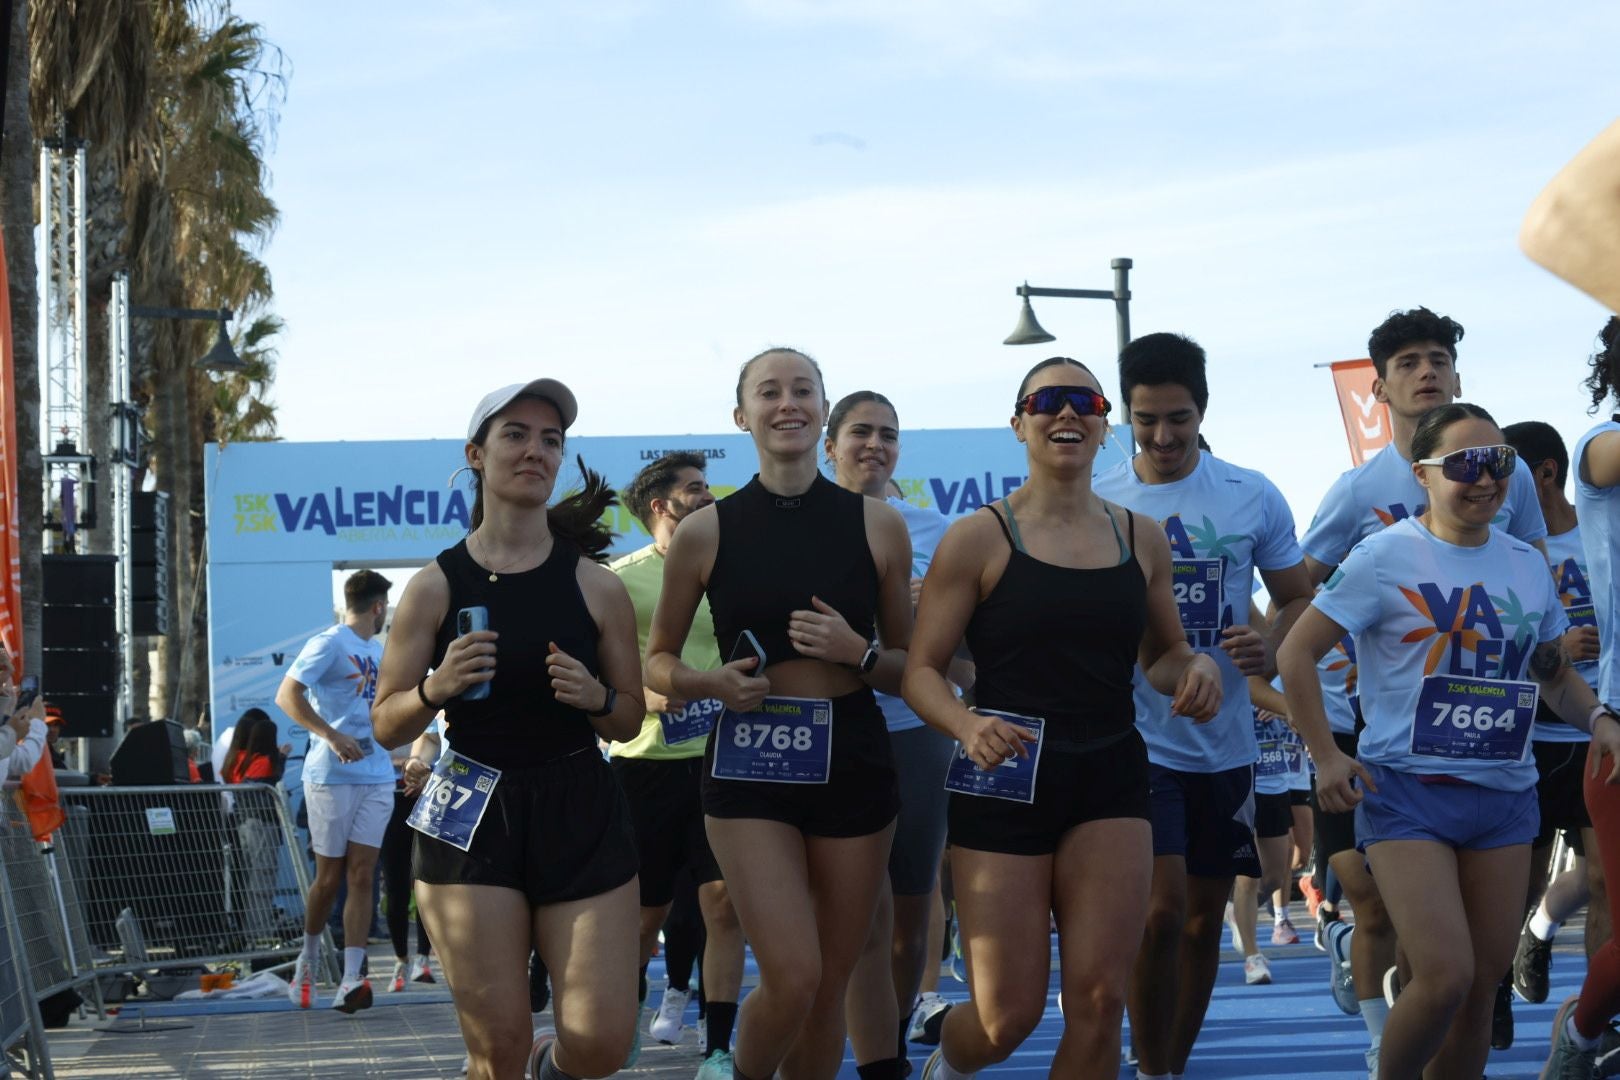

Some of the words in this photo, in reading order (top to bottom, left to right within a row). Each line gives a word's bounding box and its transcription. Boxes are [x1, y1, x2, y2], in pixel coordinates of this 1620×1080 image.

[640, 449, 660, 460] LAS
[234, 494, 270, 513] 15K
[274, 485, 471, 535] VALENCIA
[233, 513, 277, 535] 7.5K
[1417, 582, 1504, 638] VA
[1468, 685, 1506, 697] VALENCIA
[664, 698, 724, 725] 10435
[766, 704, 802, 715] VALENCIA
[1432, 701, 1516, 733] 7664
[733, 722, 813, 751] 8768
